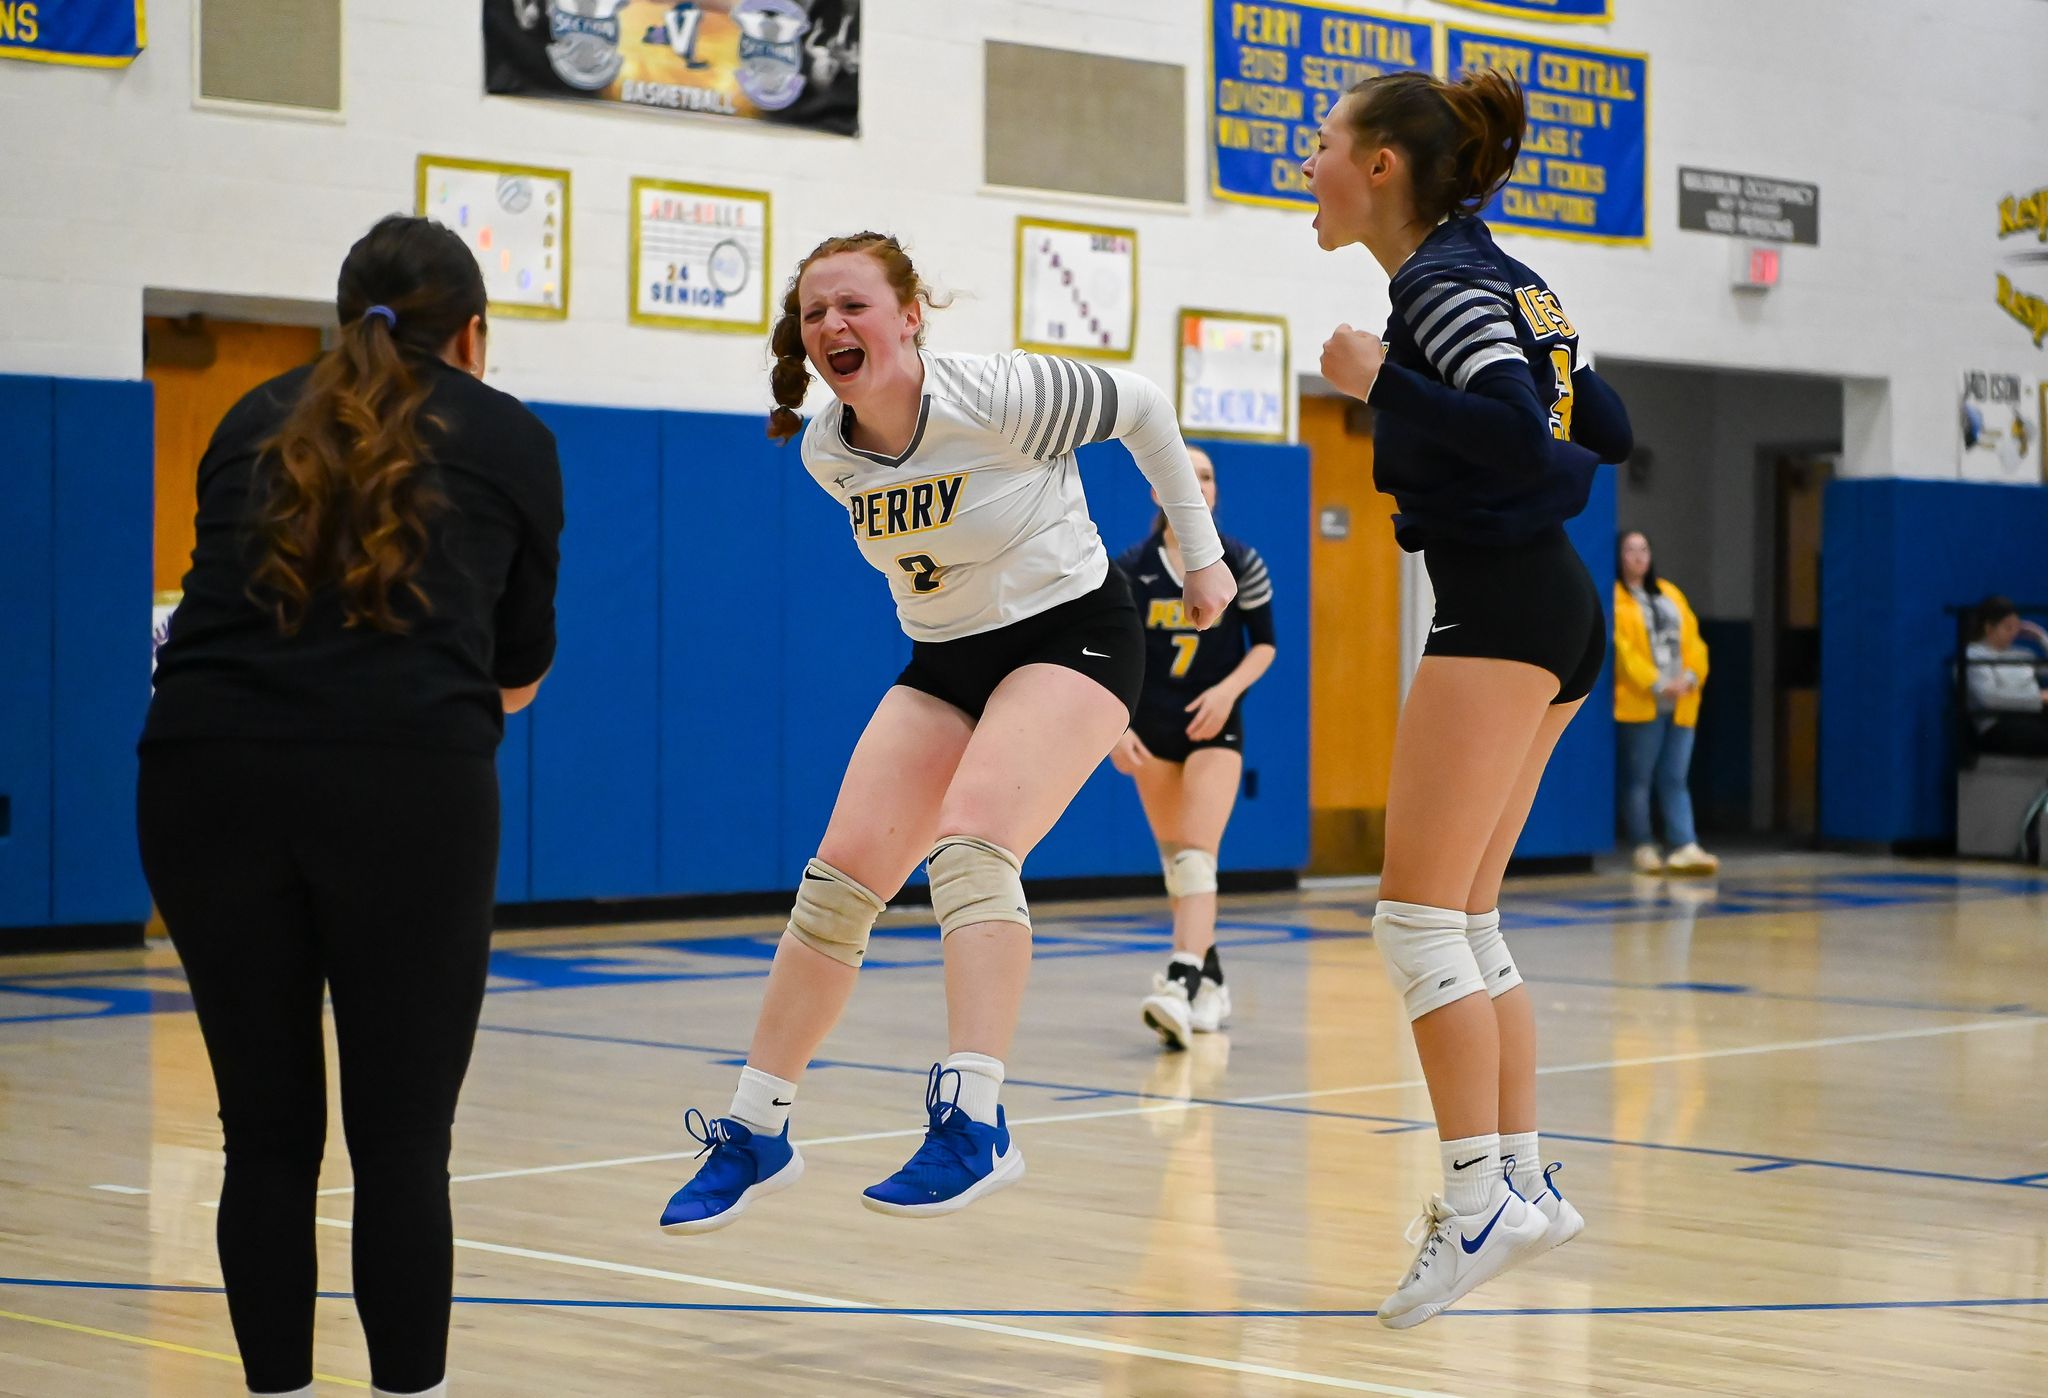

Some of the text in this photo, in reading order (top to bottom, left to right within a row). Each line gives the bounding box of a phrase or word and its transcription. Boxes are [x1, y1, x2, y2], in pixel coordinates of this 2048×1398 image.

[1231, 3, 1416, 67] PERRY CENTRAL
[620, 78, 737, 114] BASKETBALL
[1538, 52, 1636, 100] CENTRAL
[1219, 78, 1304, 121] DIVISION
[1545, 158, 1606, 194] TENNIS
[1502, 187, 1597, 226] CHAMPIONS
[651, 282, 726, 311] SENIOR
[850, 473, 968, 540] PERRY
[896, 552, 943, 594] 2
[1169, 634, 1200, 679] 7
